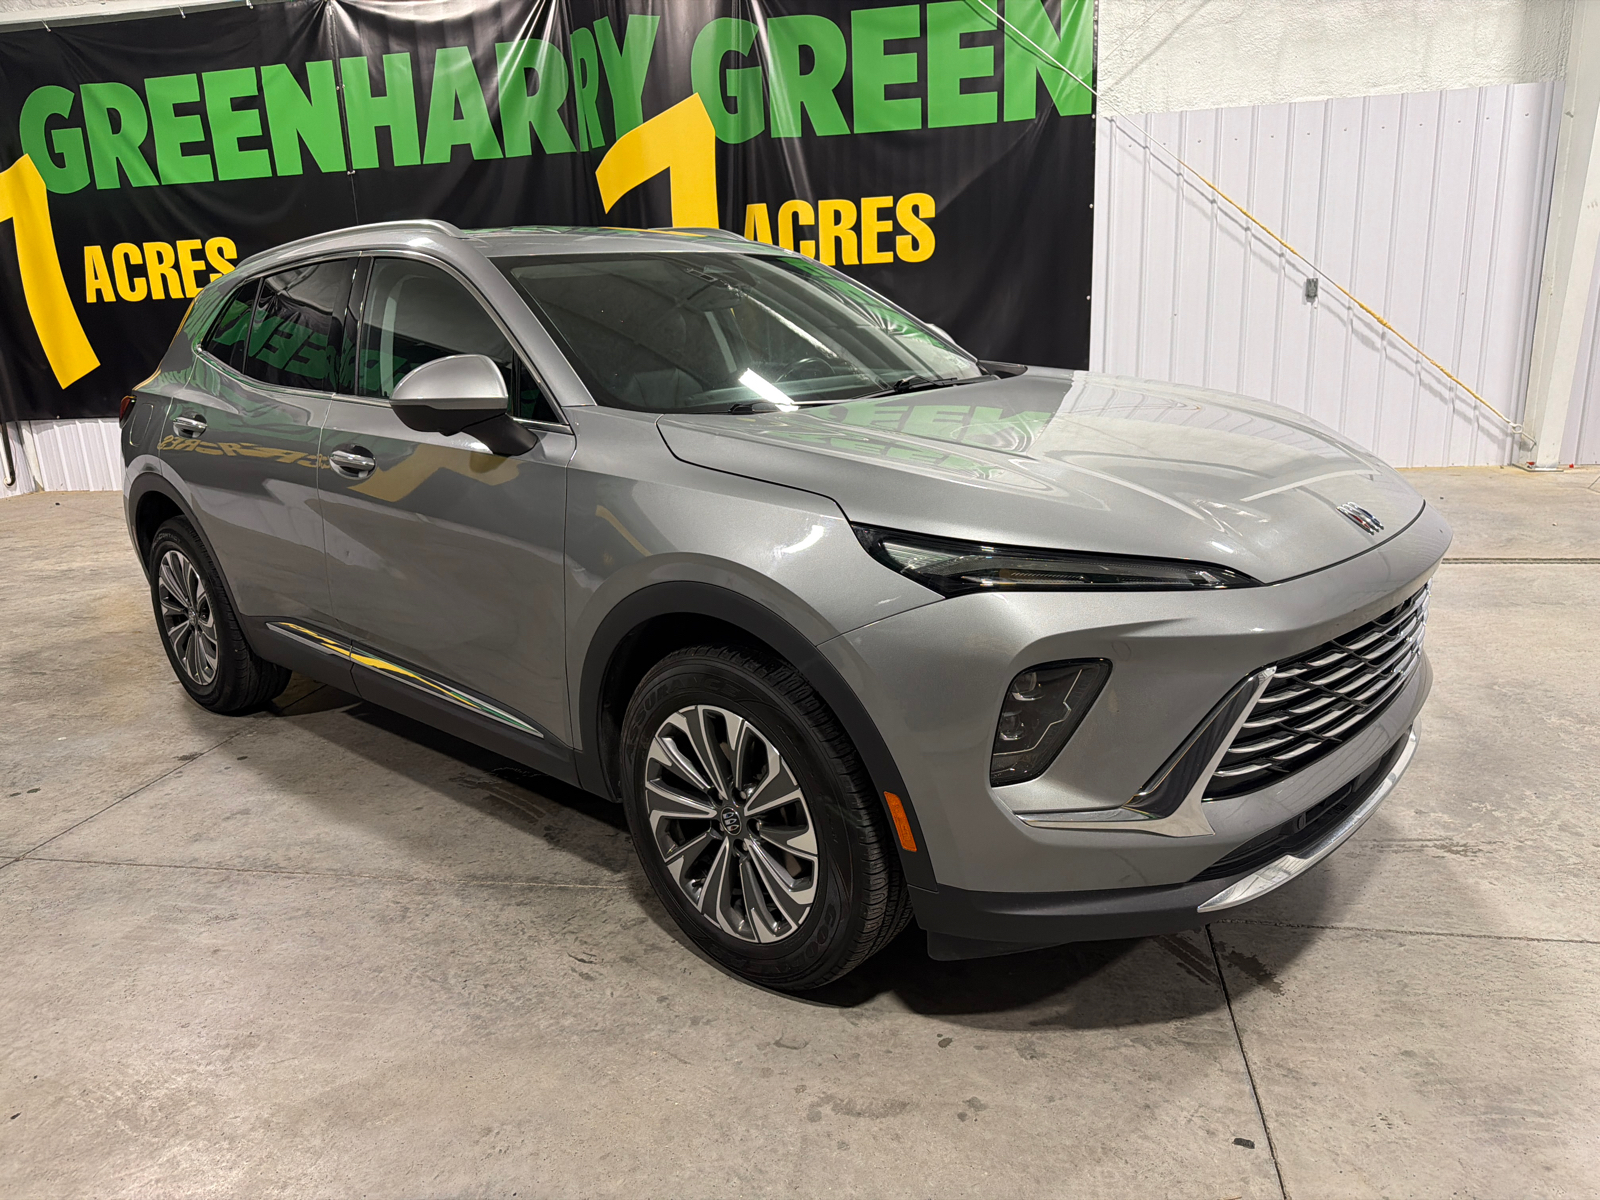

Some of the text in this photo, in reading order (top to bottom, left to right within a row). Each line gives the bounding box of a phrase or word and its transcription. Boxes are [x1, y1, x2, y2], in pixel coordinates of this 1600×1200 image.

[691, 0, 1093, 144] GREEN
[743, 192, 936, 267] ACRES
[83, 236, 238, 304] ACRES
